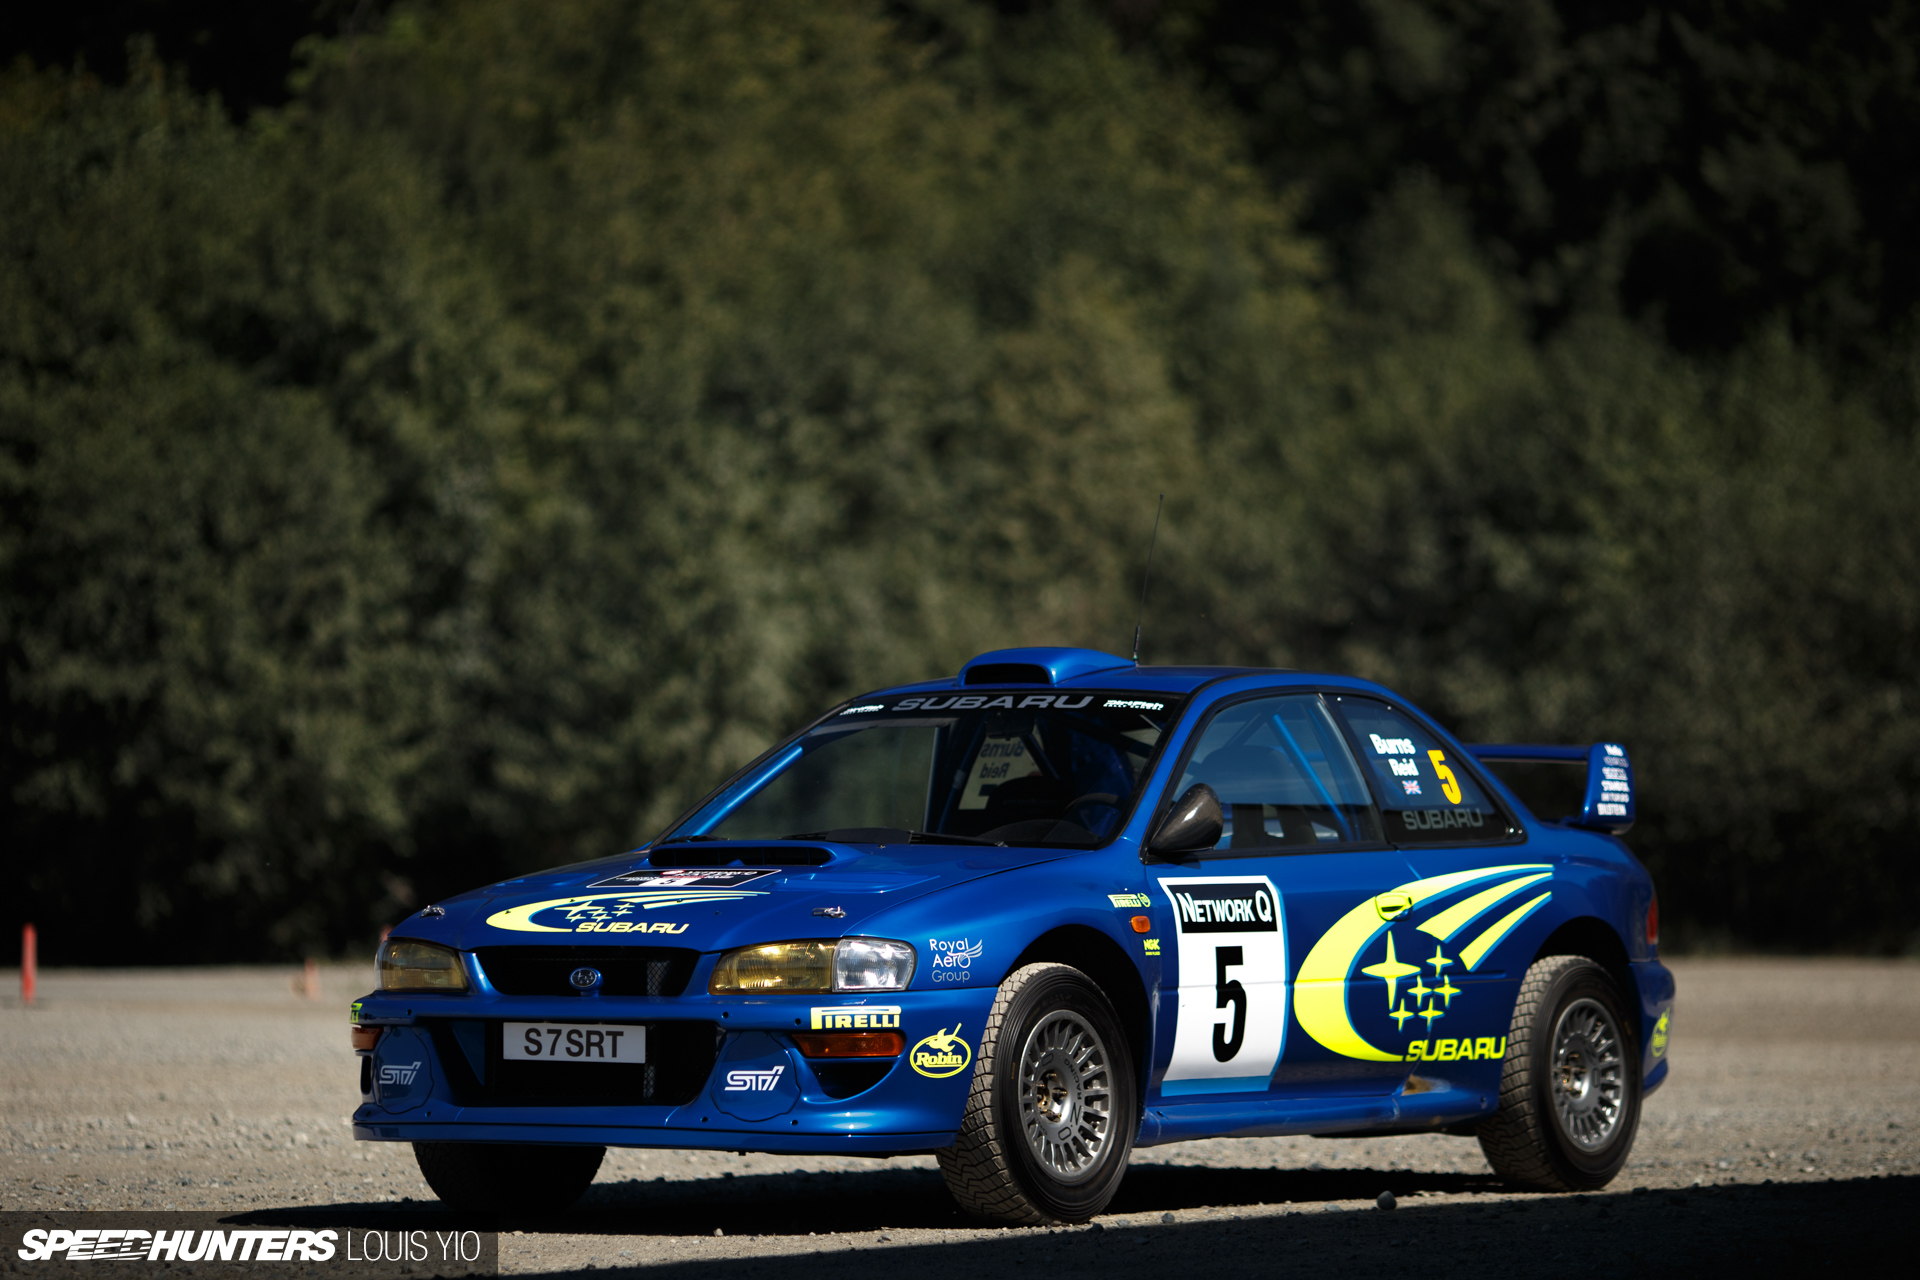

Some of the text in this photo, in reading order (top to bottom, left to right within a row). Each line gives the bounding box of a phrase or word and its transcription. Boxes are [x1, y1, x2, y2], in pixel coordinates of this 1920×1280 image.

[892, 695, 1095, 712] SUBARU
[1369, 733, 1416, 755] Burns
[1388, 757, 1420, 777] Reid
[1427, 749, 1462, 805] 5
[1402, 808, 1484, 831] SUBARU
[1255, 889, 1274, 923] Q
[575, 921, 690, 935] SUBARU
[929, 937, 969, 958] Royal
[1143, 938, 1161, 951] NGK
[931, 968, 971, 984] Group
[1212, 945, 1247, 1063] 5
[810, 1005, 902, 1030] PIRELLI
[915, 1050, 963, 1069] Robin
[1406, 1036, 1507, 1063] SUBARU
